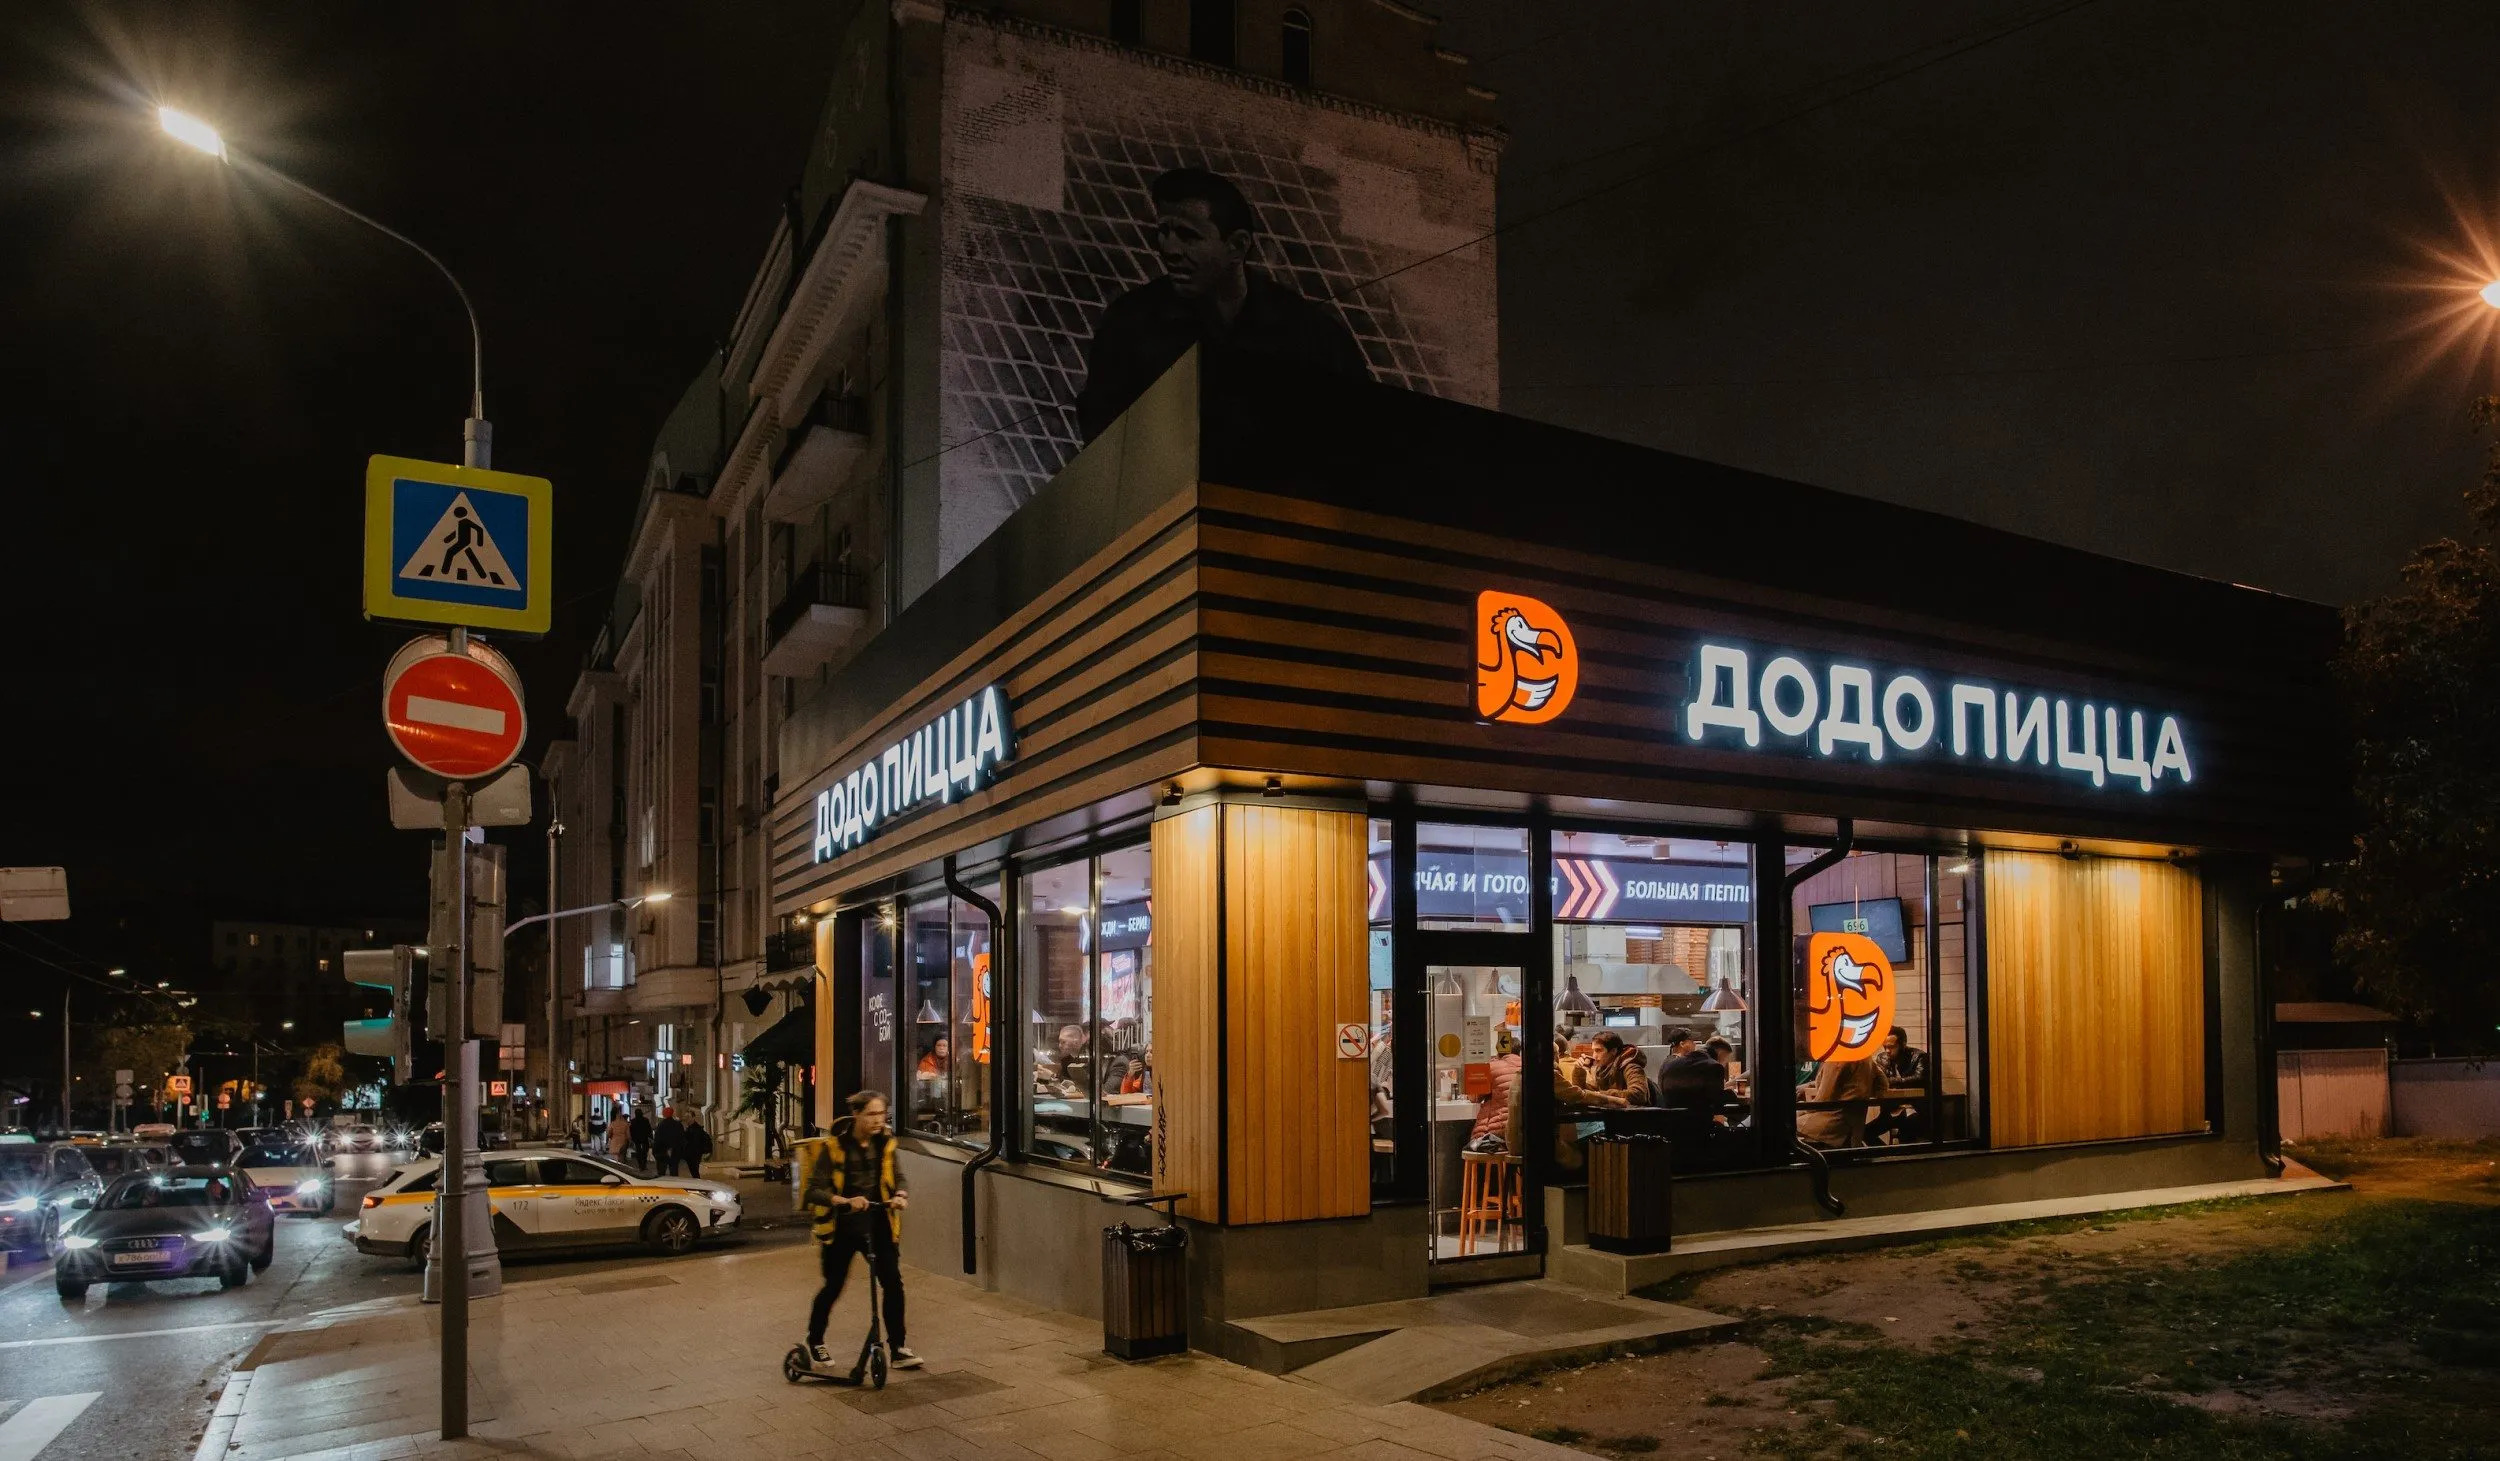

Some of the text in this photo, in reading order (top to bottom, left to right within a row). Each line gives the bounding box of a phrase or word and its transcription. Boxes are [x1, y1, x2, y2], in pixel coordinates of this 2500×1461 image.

[1686, 644, 2192, 792] ДОДО ПИЦЦА
[814, 685, 1004, 864] ДОДО ПИЦЦА
[1462, 873, 1477, 893] И
[1626, 880, 1700, 901] БОЛЬШАЯ
[574, 1197, 602, 1208] Яндекс
